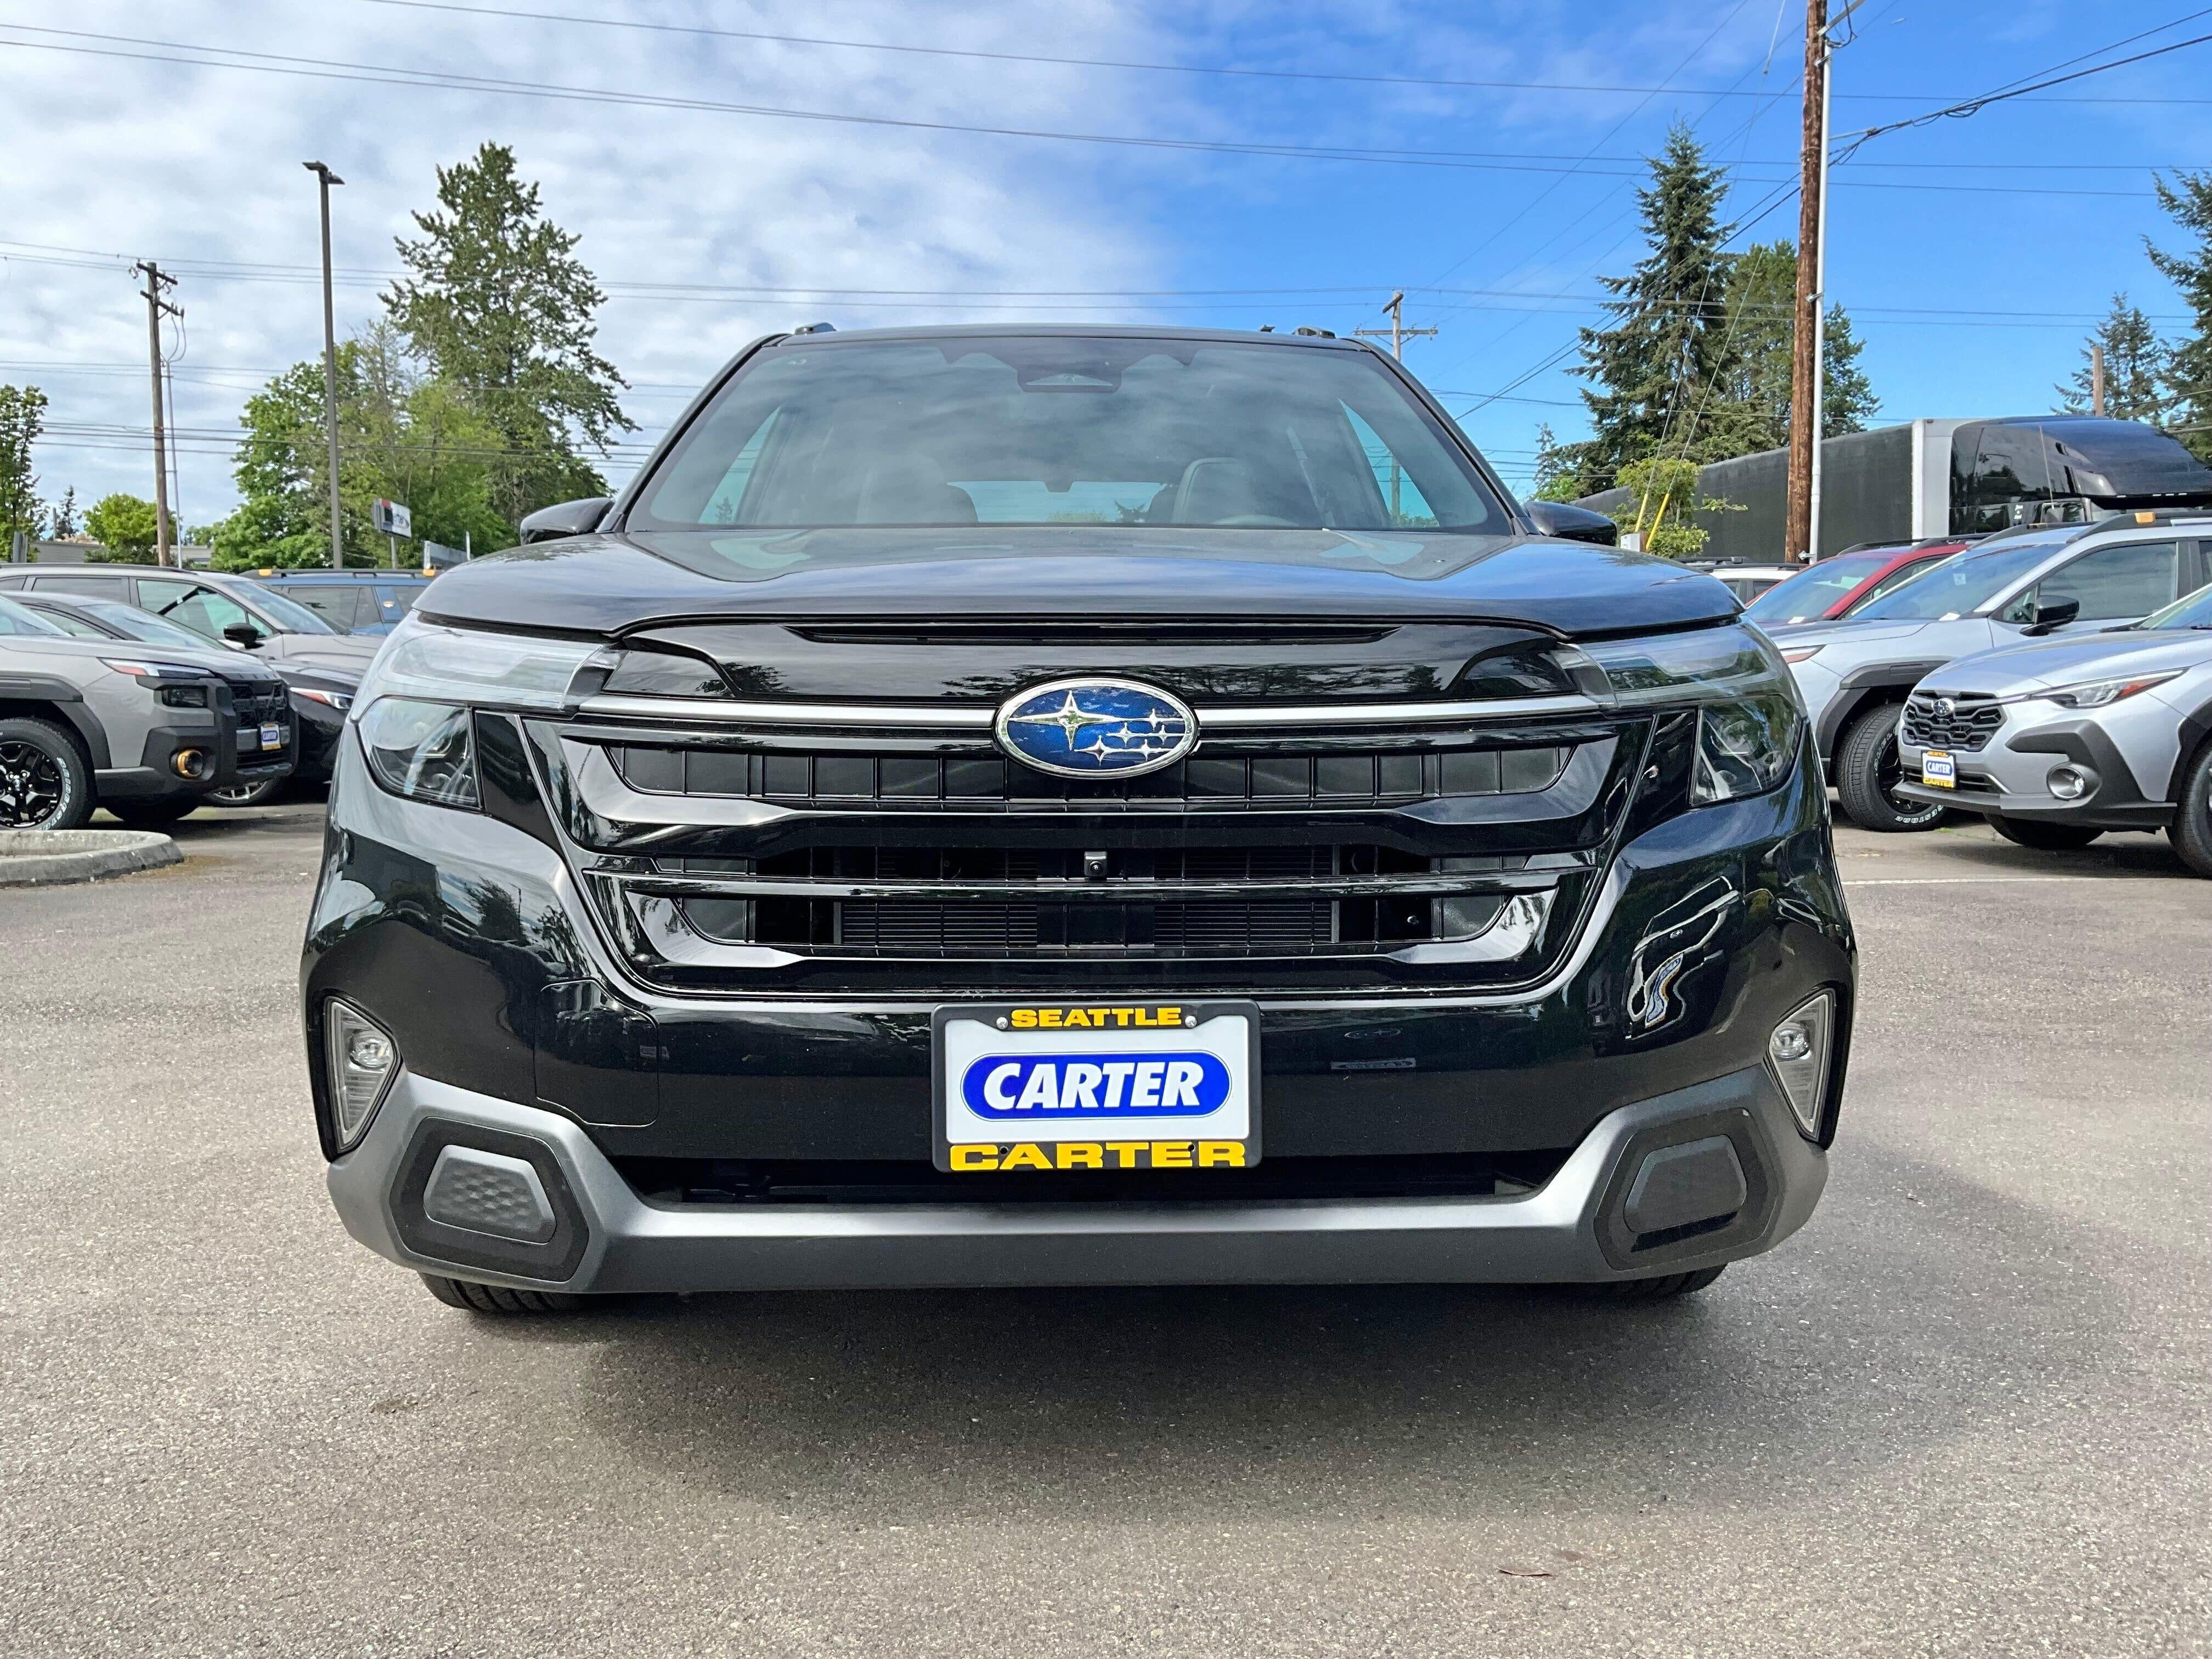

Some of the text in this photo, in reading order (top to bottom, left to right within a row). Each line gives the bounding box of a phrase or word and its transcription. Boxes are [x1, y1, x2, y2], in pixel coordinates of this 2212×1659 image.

[1927, 761, 1951, 774] CARTER
[41, 757, 71, 830] BRIDGESTO
[1011, 1007, 1182, 1028] SEATTLE
[984, 1061, 1204, 1110] CARTER
[950, 1141, 1246, 1171] CARTER
